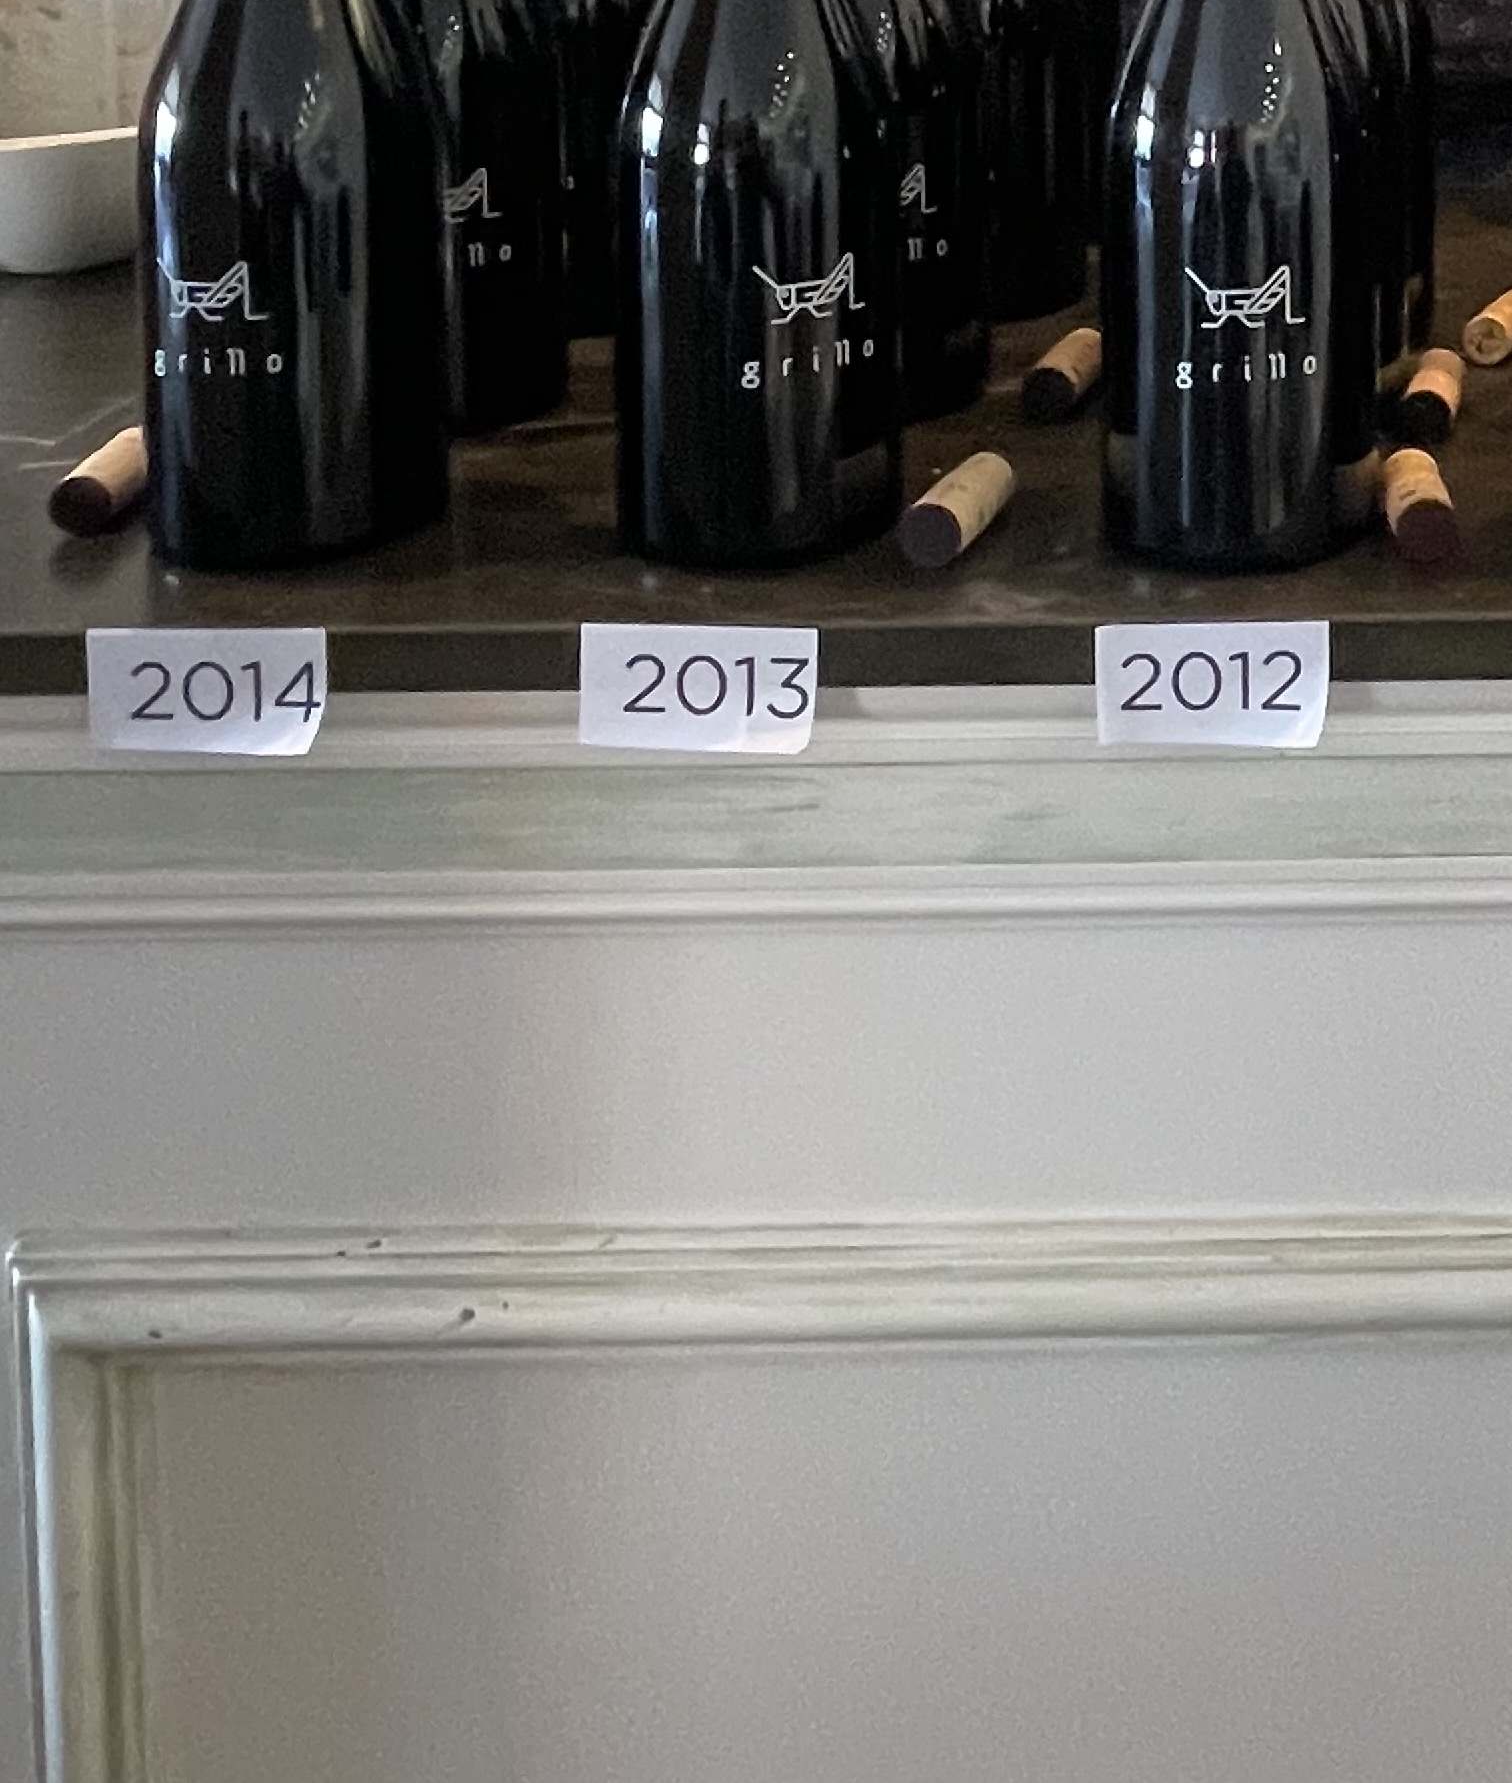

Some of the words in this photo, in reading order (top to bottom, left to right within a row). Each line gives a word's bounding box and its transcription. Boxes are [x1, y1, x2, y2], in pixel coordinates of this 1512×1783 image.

[129, 659, 322, 723] 2014
[621, 653, 811, 720] 2013
[1119, 649, 1304, 713] 2012
